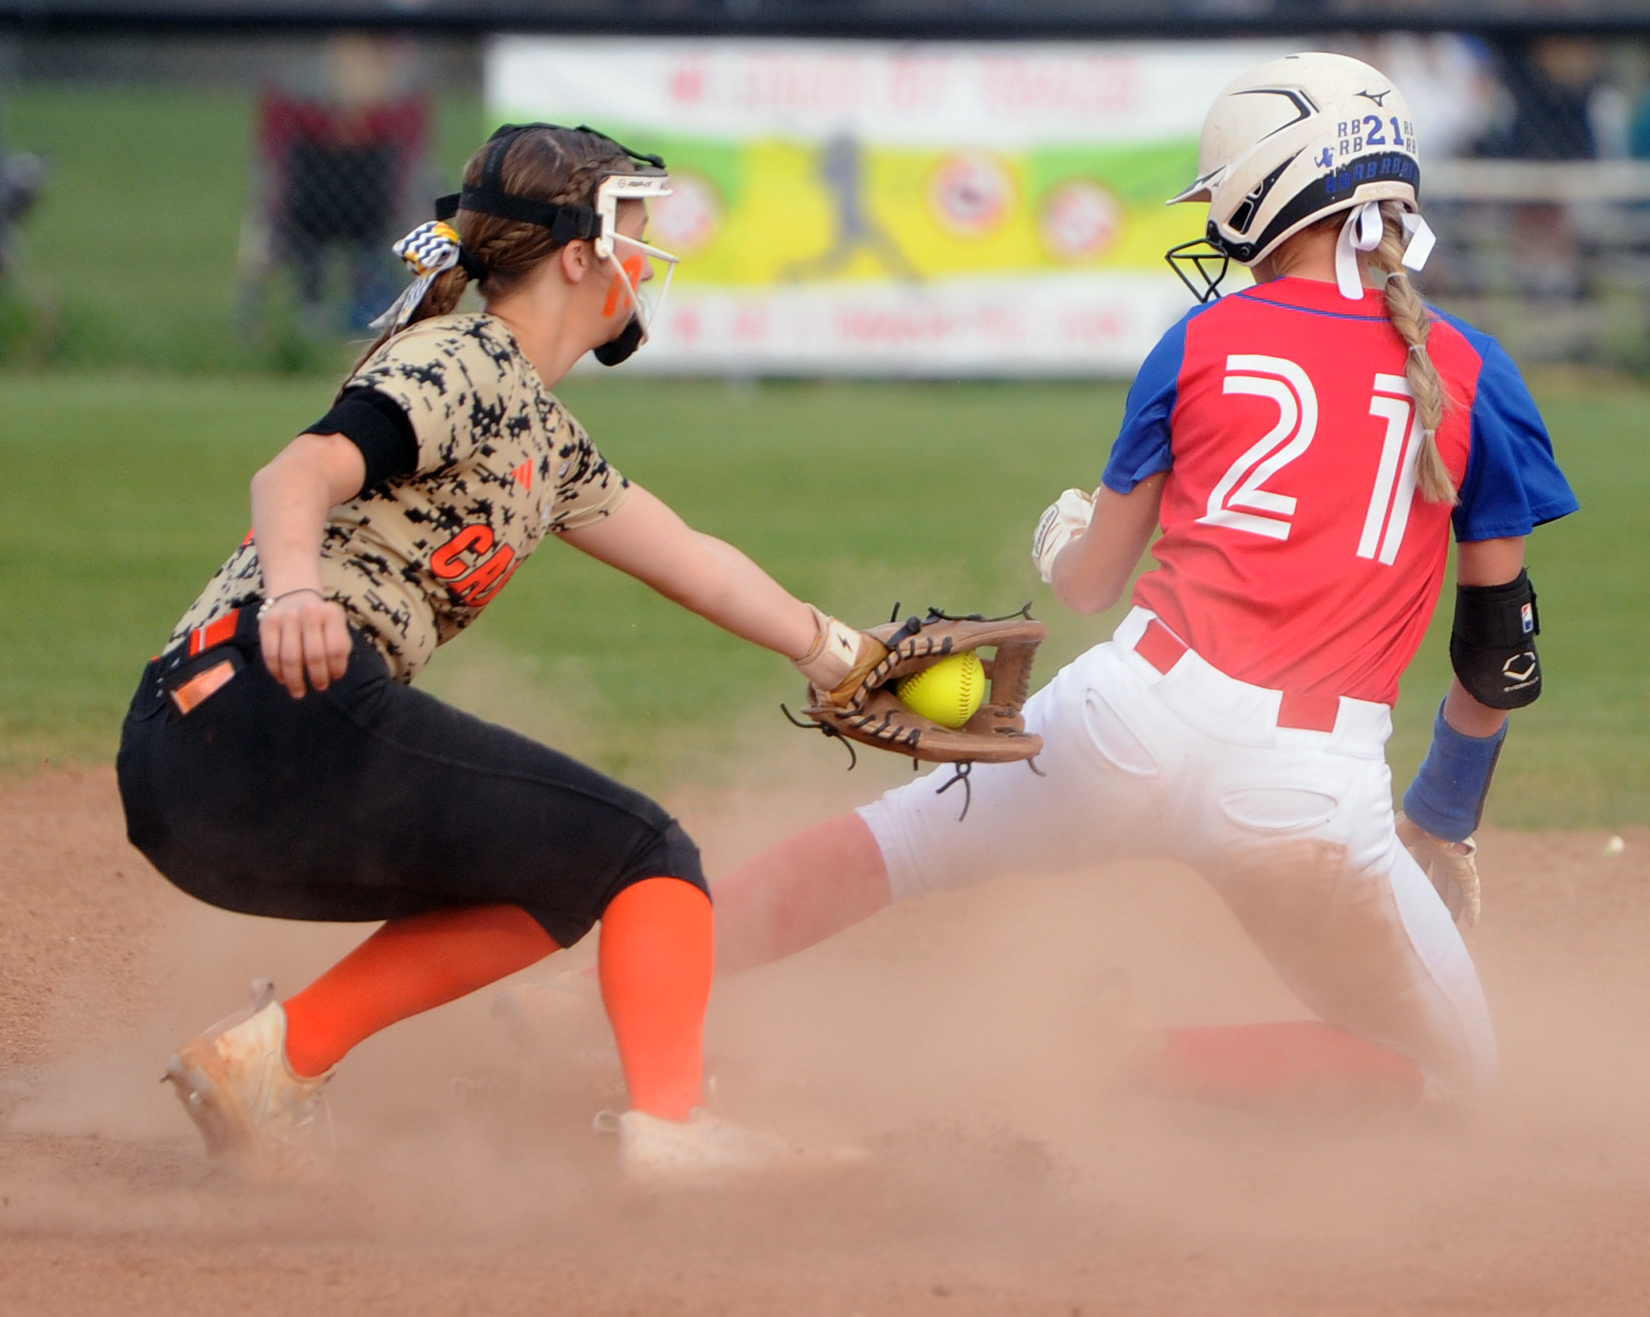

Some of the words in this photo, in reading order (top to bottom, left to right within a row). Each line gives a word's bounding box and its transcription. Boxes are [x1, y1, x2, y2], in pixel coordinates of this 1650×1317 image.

[1337, 119, 1361, 137] RB
[1363, 115, 1404, 146] 21
[1339, 137, 1363, 155] RB
[1194, 354, 1424, 566] 21
[430, 523, 522, 608] CA
